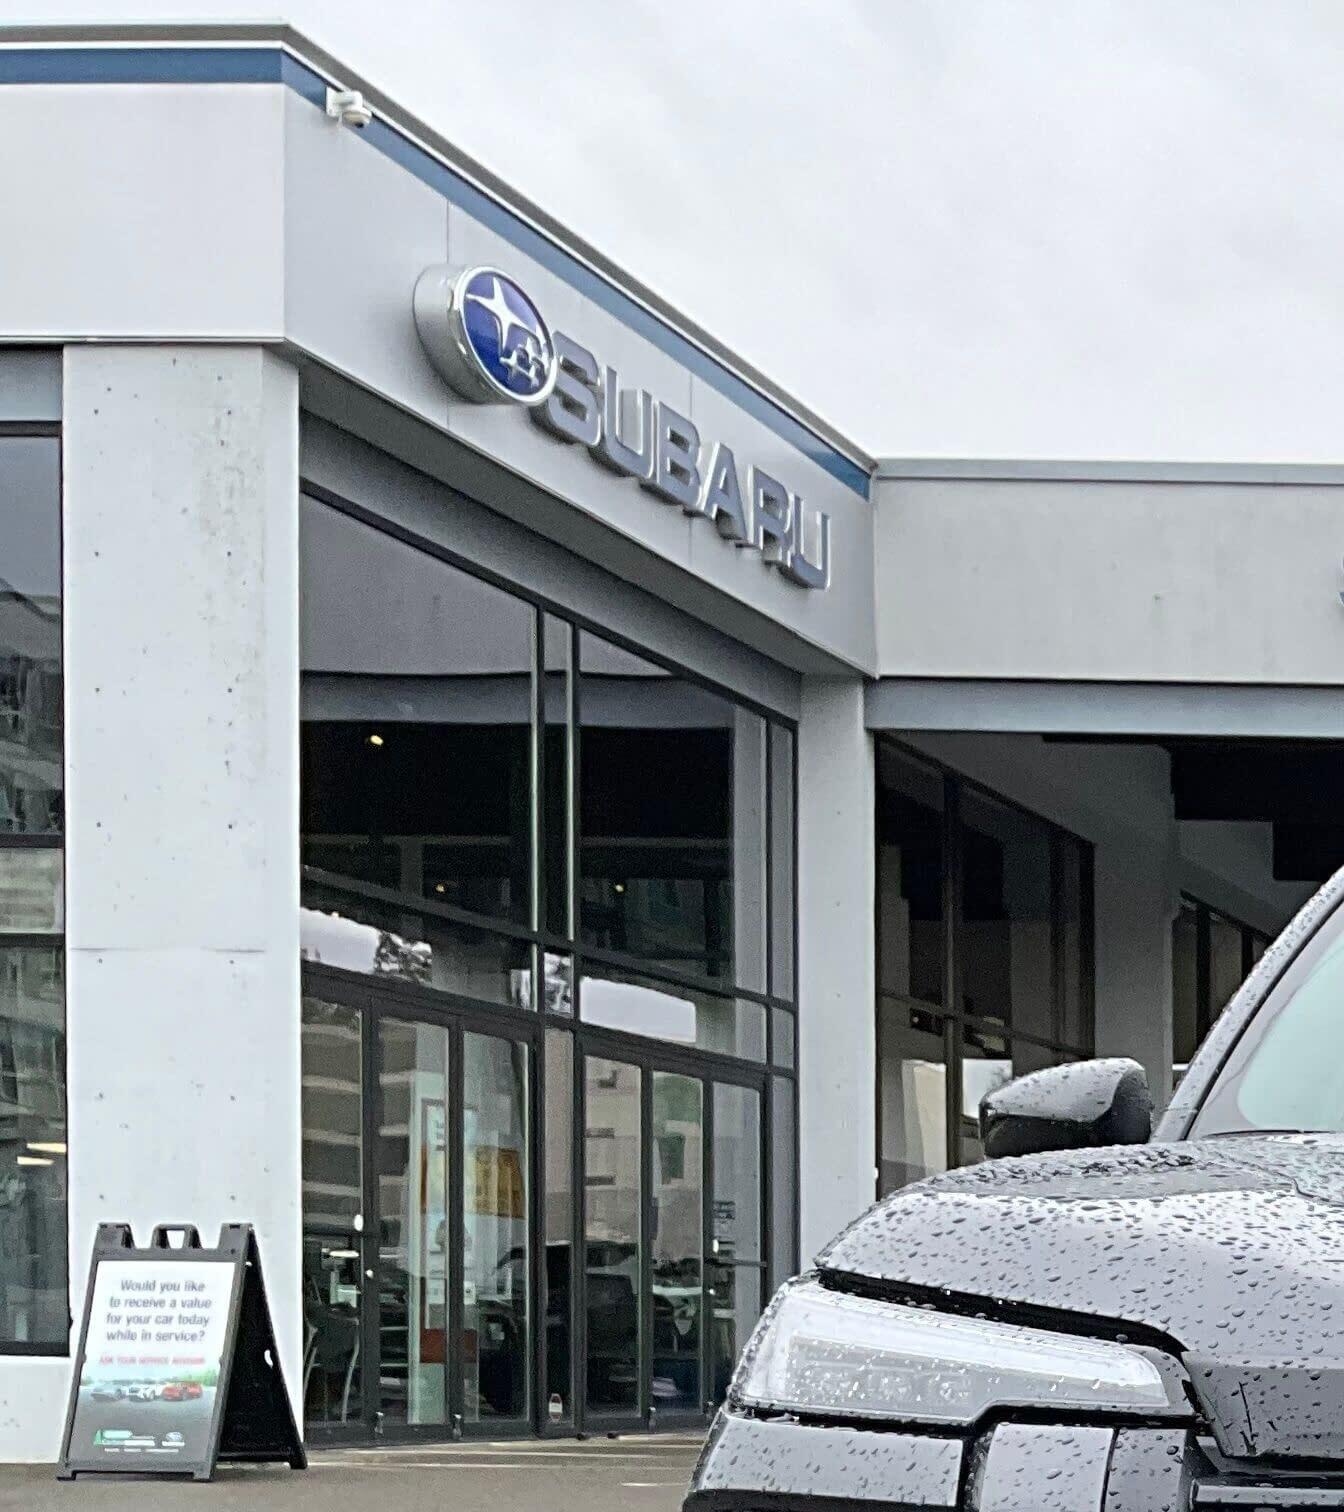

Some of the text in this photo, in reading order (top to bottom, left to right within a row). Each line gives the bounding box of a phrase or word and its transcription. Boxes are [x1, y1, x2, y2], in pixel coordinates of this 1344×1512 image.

[546, 330, 831, 591] SUBARU
[121, 1279, 206, 1294] Would you like
[109, 1296, 212, 1309] to receive a value
[106, 1312, 210, 1327] for your car today
[107, 1329, 205, 1342] while in service?
